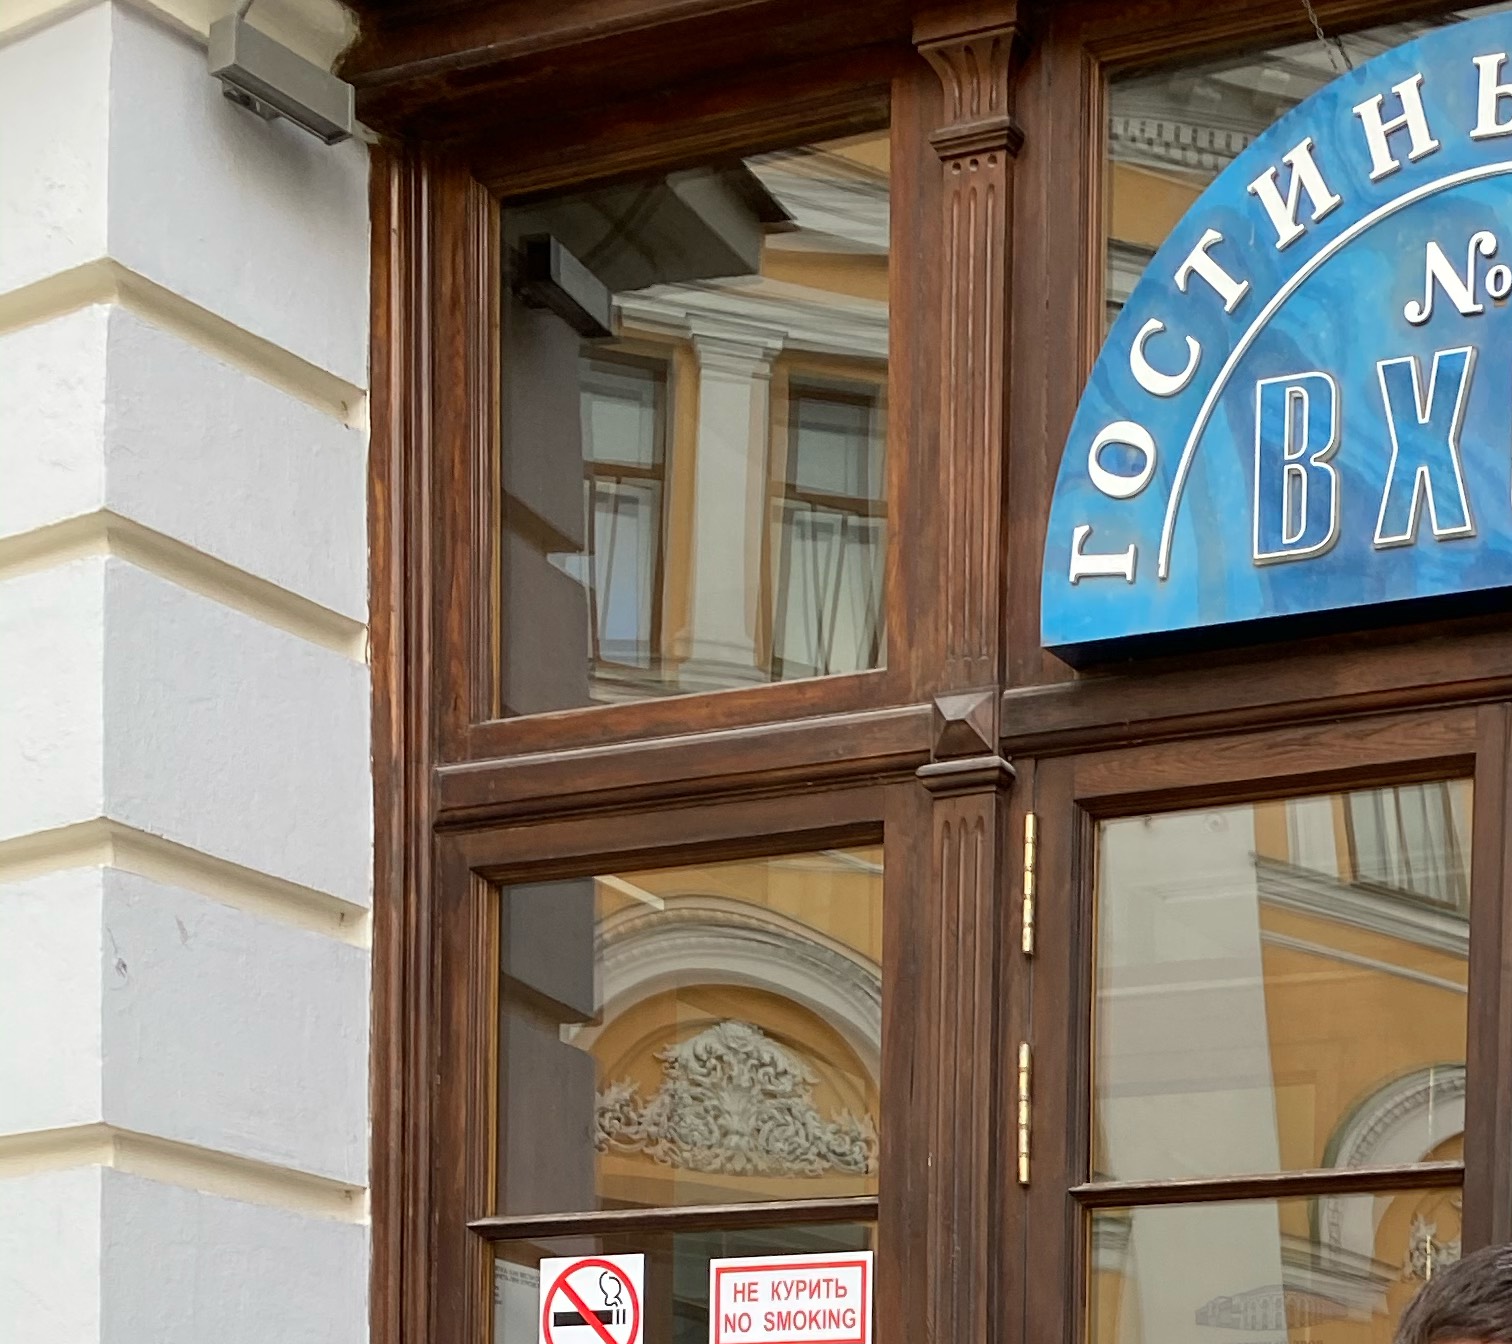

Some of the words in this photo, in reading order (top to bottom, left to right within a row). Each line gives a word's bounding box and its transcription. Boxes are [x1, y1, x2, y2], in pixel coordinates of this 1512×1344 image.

[733, 1282, 758, 1303] НЕ
[771, 1278, 848, 1301] КУРИТЬ
[724, 1313, 752, 1333] NO
[763, 1308, 857, 1332] SMOKING
